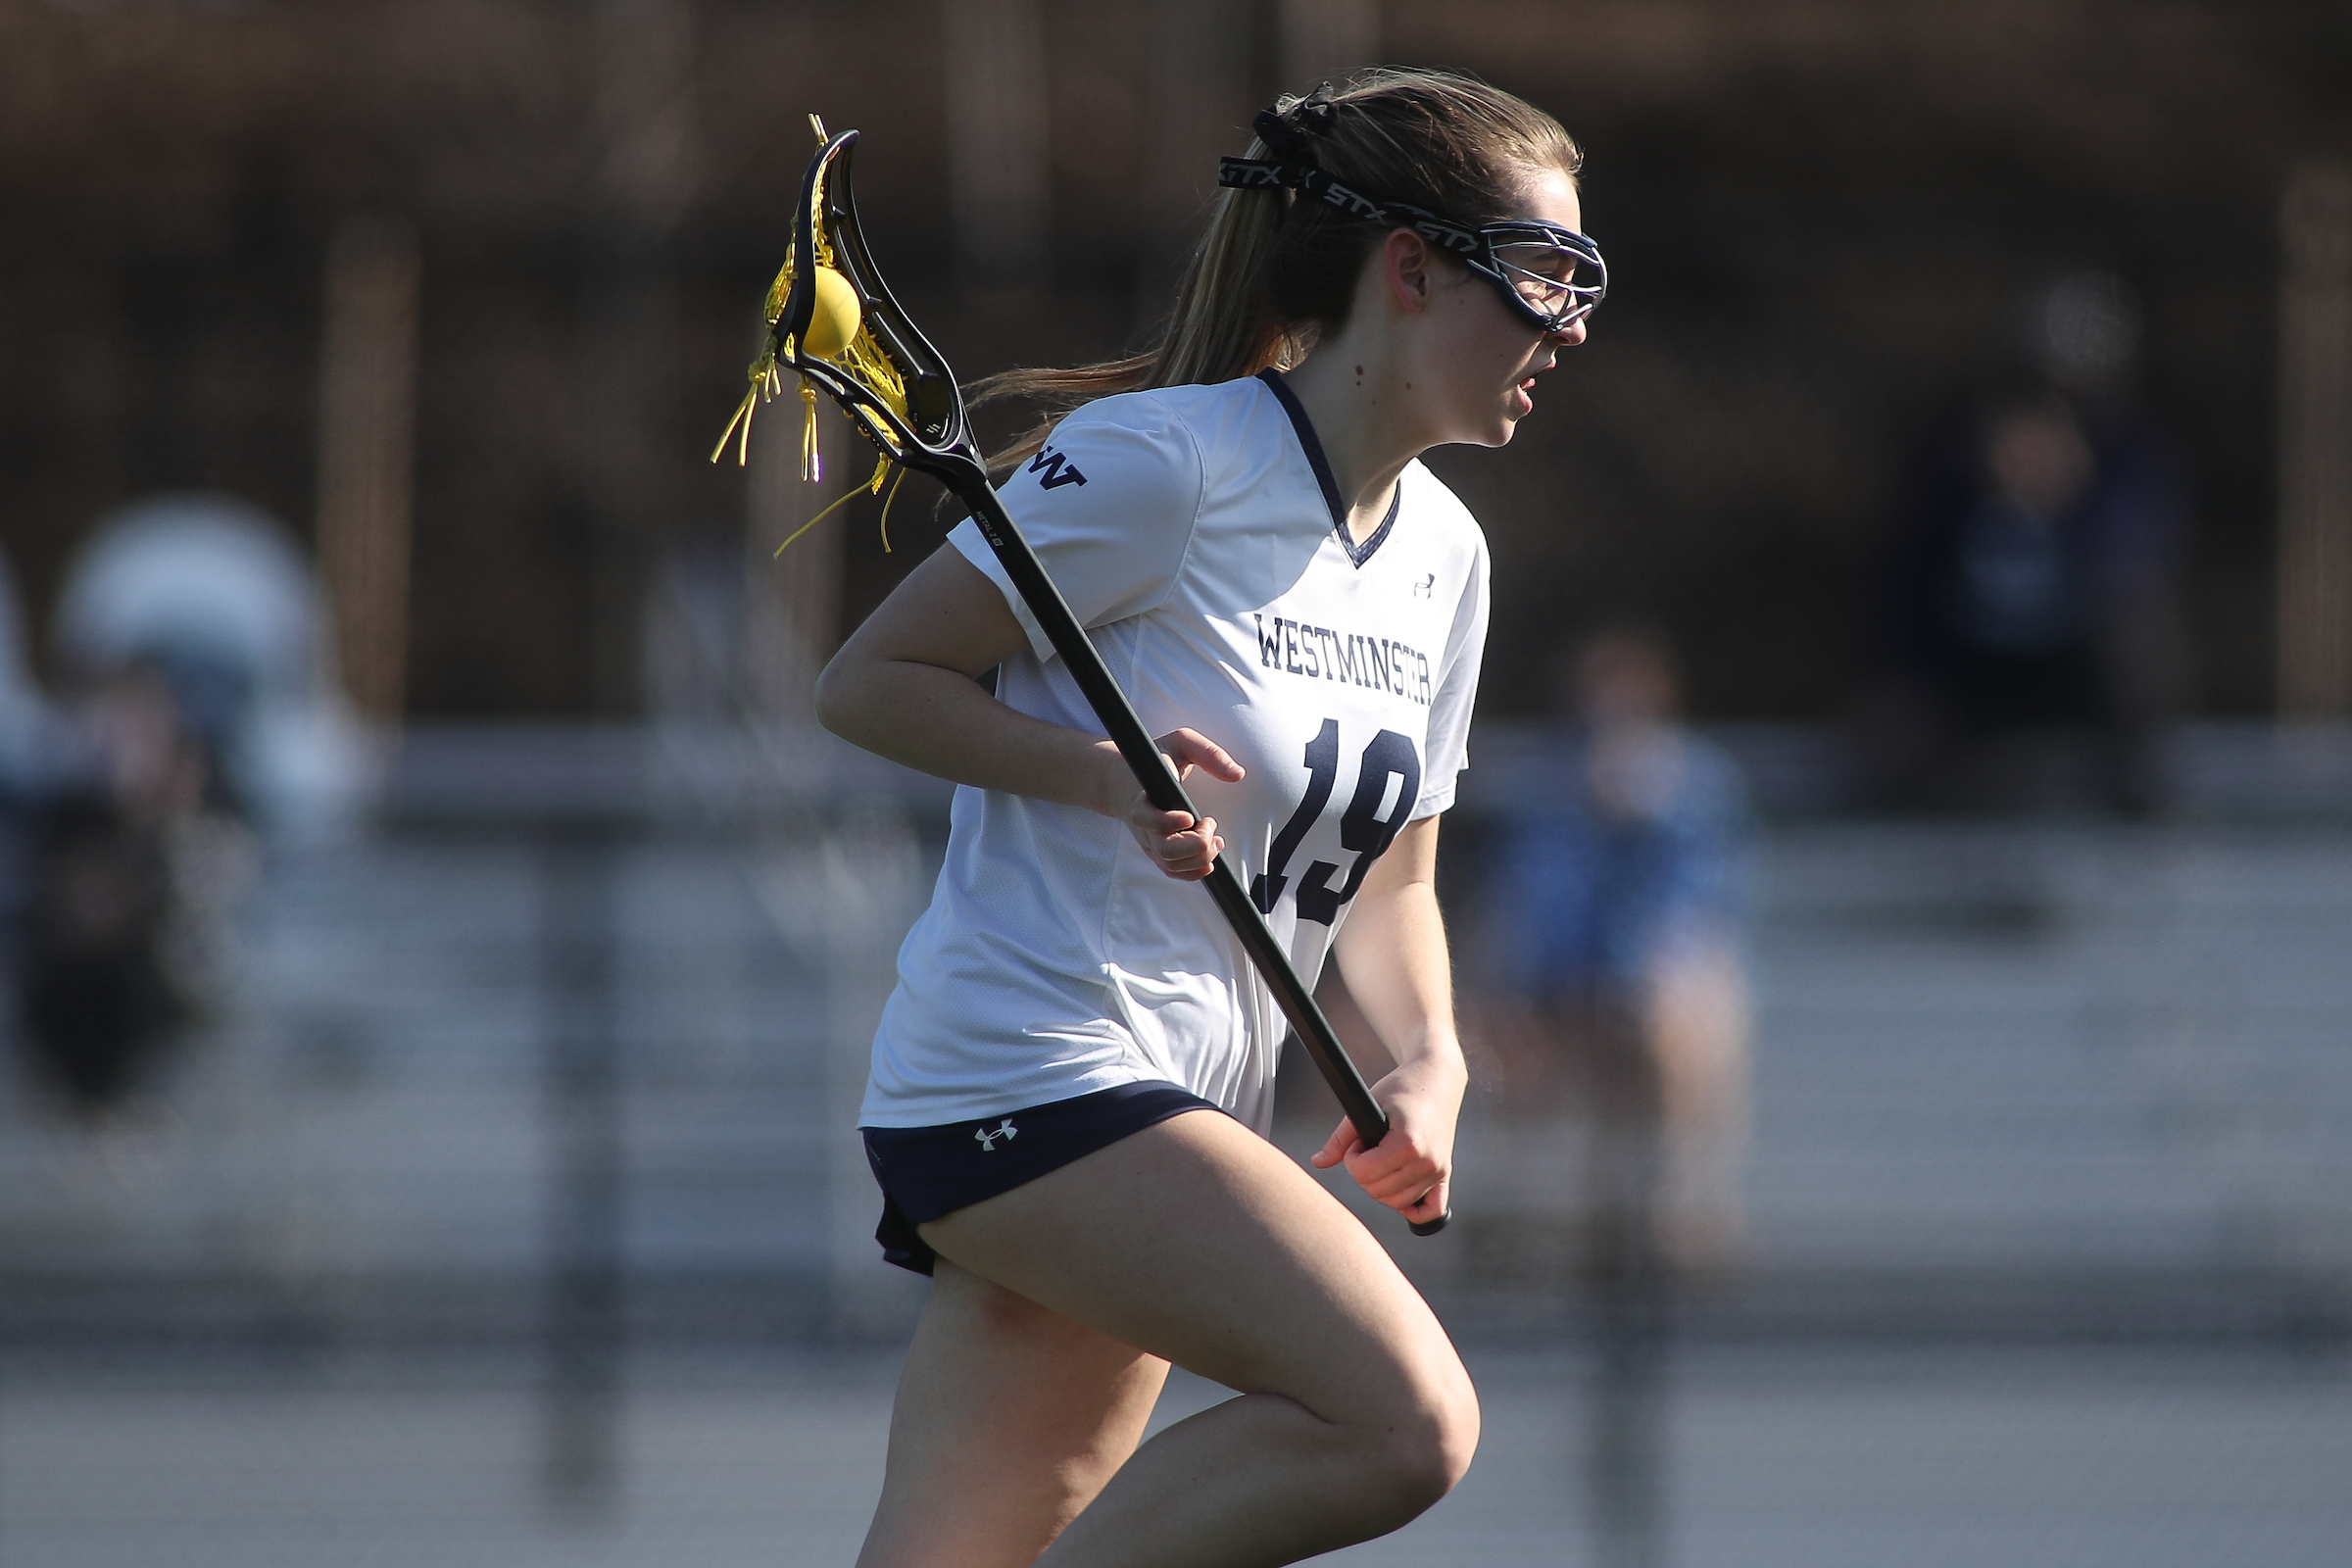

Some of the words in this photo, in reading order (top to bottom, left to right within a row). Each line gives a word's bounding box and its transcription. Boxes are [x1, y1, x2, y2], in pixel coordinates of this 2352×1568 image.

[1323, 182, 1388, 224] STX
[1028, 445, 1088, 490] W
[1253, 612, 1432, 707] WESTMINSTER
[1249, 717, 1421, 927] 19
